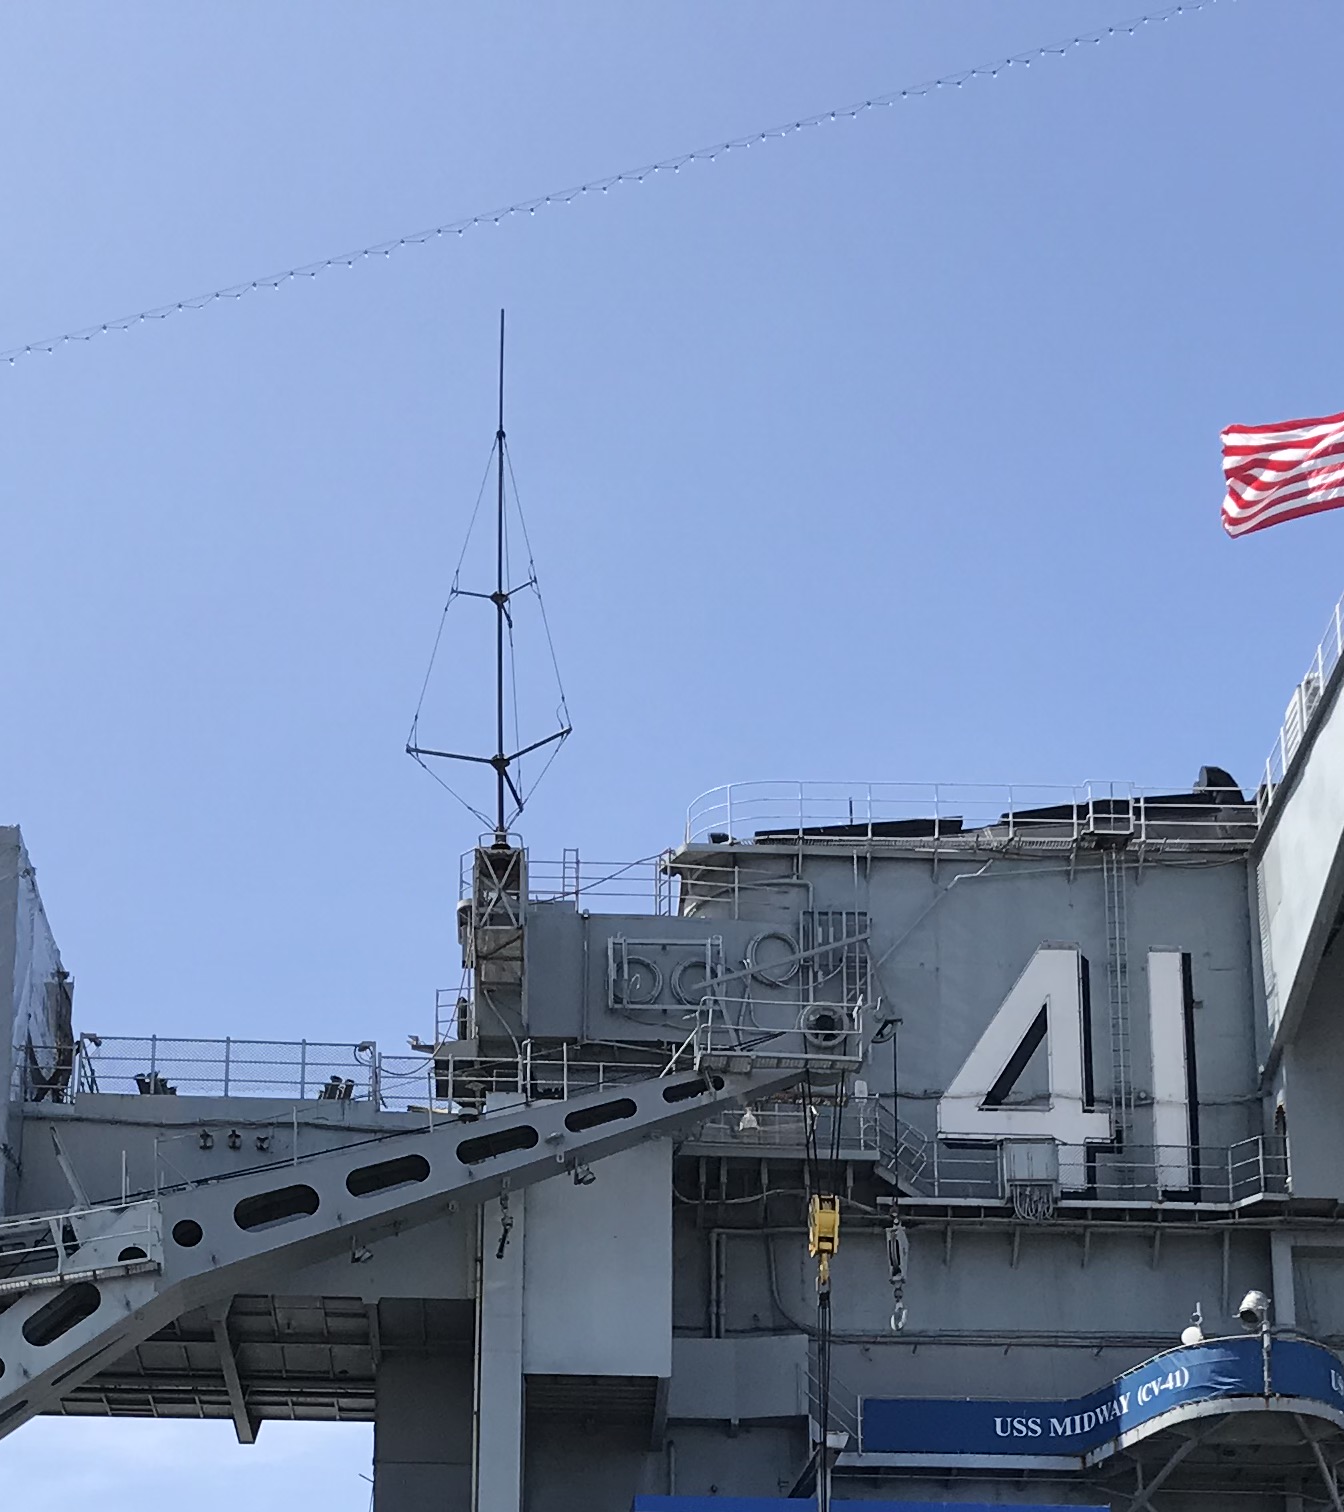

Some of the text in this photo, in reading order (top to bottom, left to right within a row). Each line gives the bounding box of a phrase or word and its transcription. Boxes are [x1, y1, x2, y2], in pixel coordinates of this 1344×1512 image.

[937, 940, 1201, 1200] 41
[994, 1365, 1190, 1438] USS MIDWAY (CV-41)
